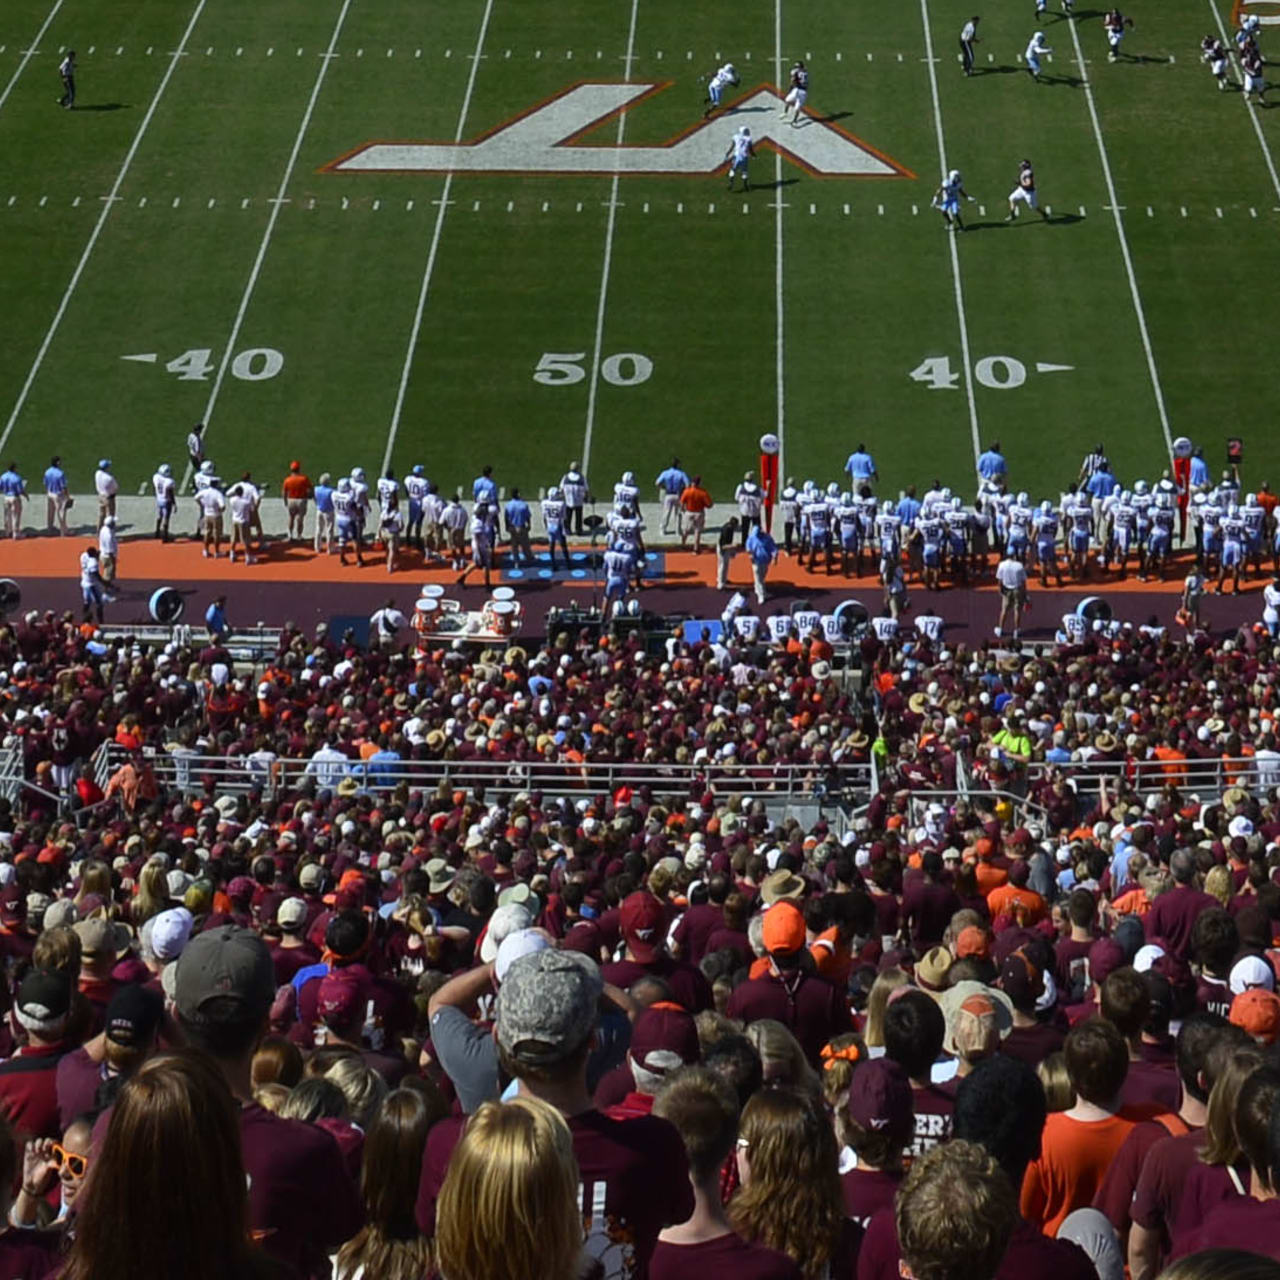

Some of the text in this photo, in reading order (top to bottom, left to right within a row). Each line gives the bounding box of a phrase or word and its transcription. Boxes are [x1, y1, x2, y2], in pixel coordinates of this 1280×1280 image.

[165, 348, 284, 381] 40
[532, 352, 653, 386] 50
[909, 354, 1027, 390] 40
[742, 620, 752, 634] 5
[776, 620, 786, 634] 6
